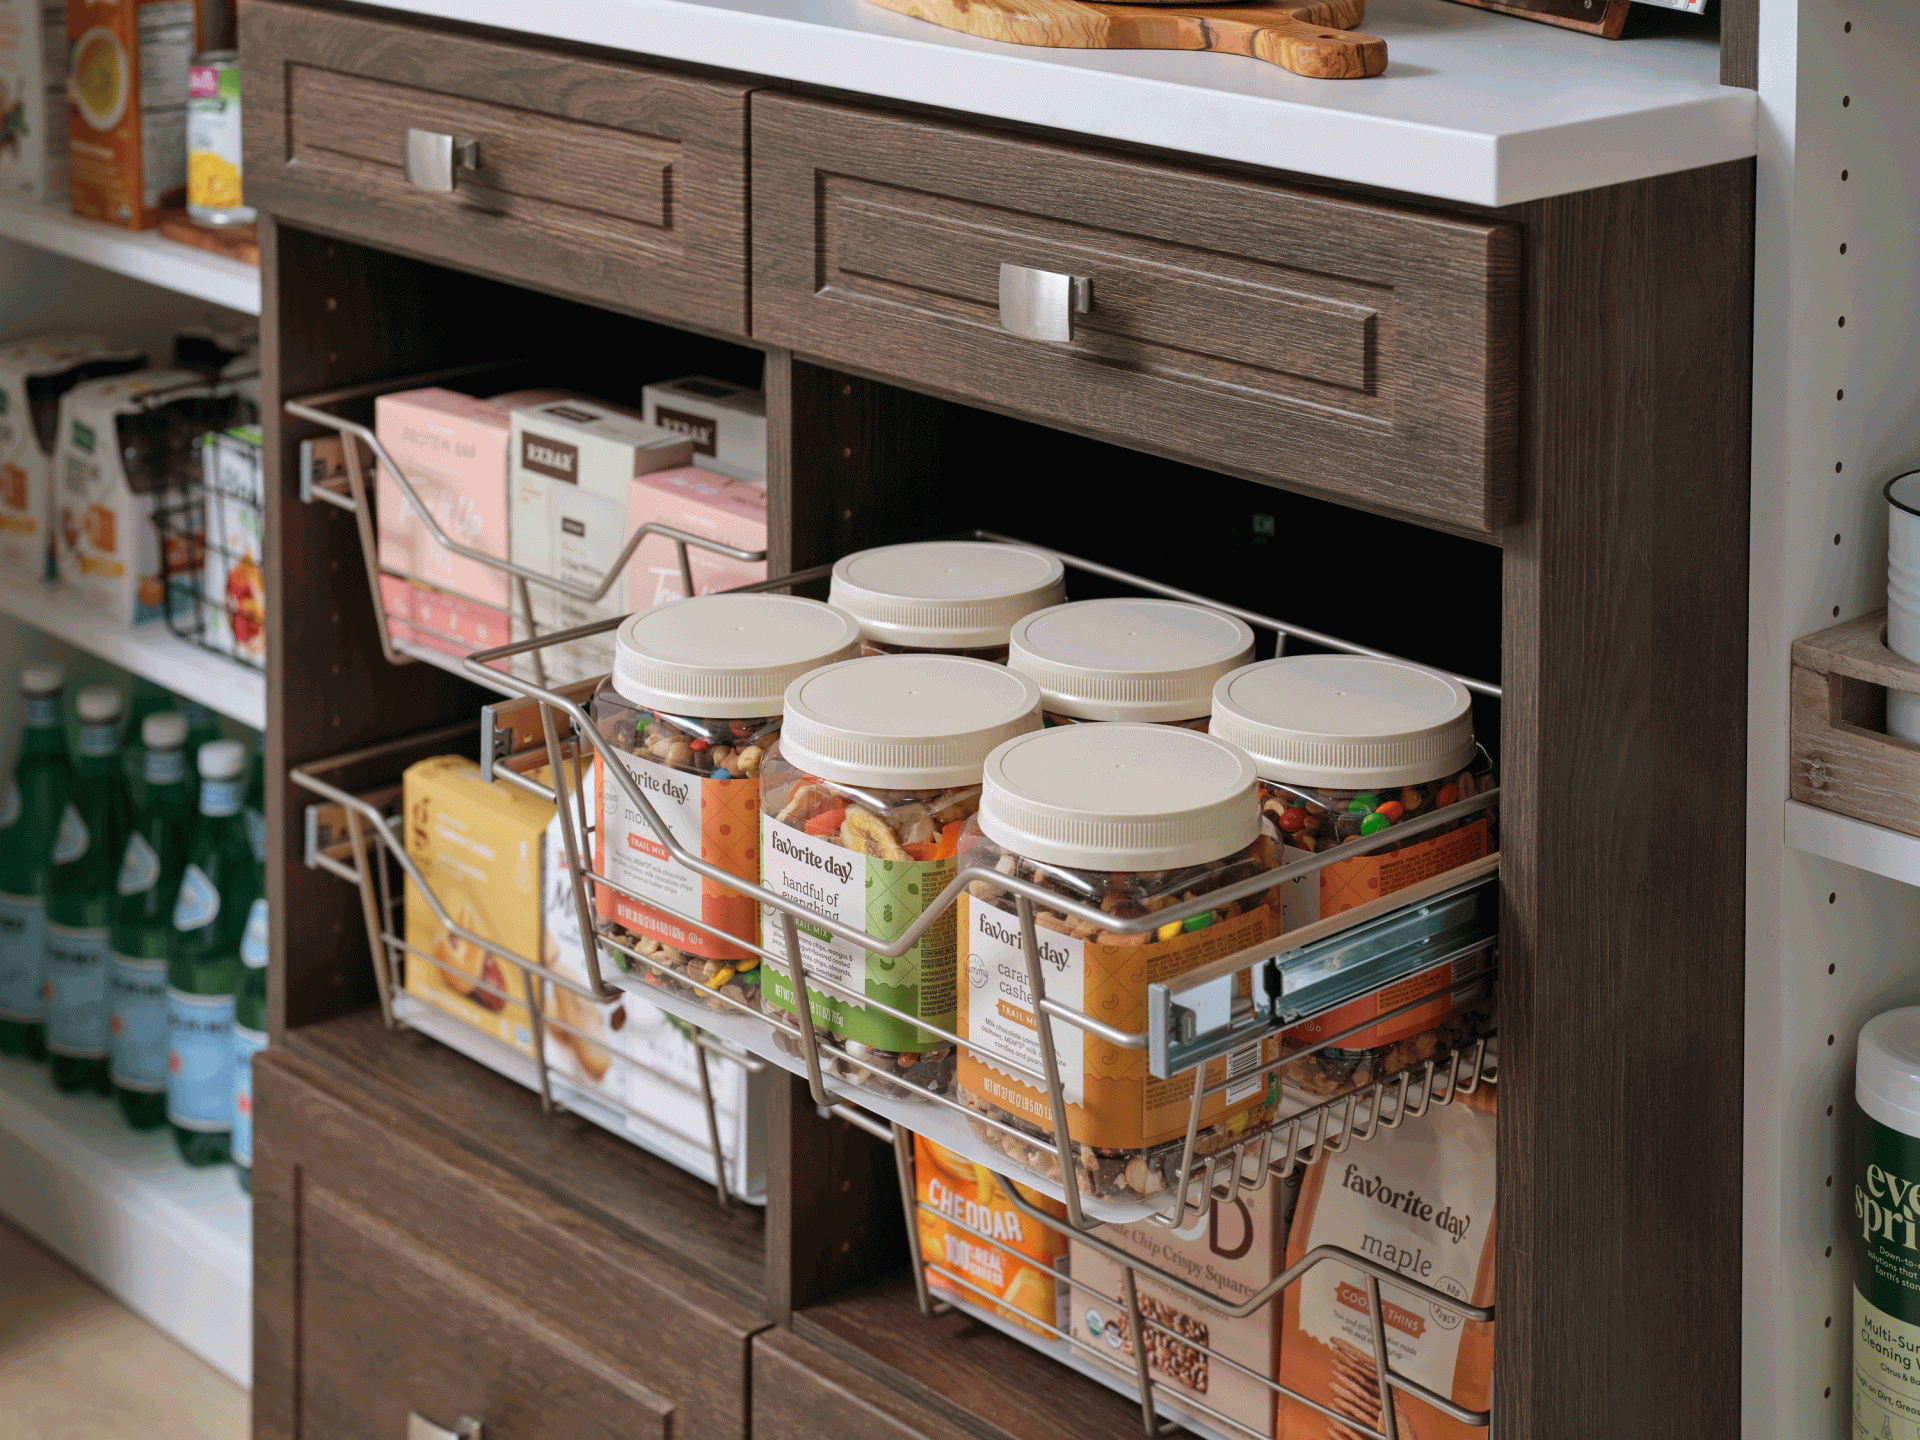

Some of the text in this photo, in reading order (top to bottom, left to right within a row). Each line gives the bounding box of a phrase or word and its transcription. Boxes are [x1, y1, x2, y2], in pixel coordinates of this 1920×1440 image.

[662, 779, 689, 806] day
[631, 837, 666, 858] TRAIL MIX
[772, 830, 852, 885] favorite day
[783, 871, 840, 908] handful of
[795, 917, 828, 938] RAIL MIX
[979, 913, 1023, 951] favori
[1038, 942, 1069, 971] day
[828, 964, 852, 978] almonds,
[832, 953, 851, 969] coated
[774, 983, 783, 998] NET
[783, 988, 791, 1002] WT
[999, 981, 1034, 1005] cashe
[1002, 1004, 1024, 1022] TRAIL
[985, 1018, 996, 1029] Milk
[995, 1025, 1022, 1041] chocolate
[994, 1041, 1015, 1056] candies
[1015, 1050, 1027, 1061] and
[984, 1077, 993, 1092] NET
[993, 1082, 1001, 1097] WT
[1001, 1086, 1008, 1101] 37
[1008, 1090, 1016, 1105] OZ
[1016, 1094, 1022, 1108] (2
[1022, 1097, 1029, 1111] LB
[1034, 1103, 1044, 1119] OZ)
[1867, 1163, 1920, 1217] eve
[928, 1178, 1023, 1242] CHEDDAR
[1342, 1163, 1471, 1244] favorite day
[1855, 1184, 1919, 1251] spri
[1131, 1228, 1161, 1257] Chip
[1162, 1245, 1202, 1279] Crispy
[1204, 1264, 1259, 1299] Squares
[1360, 1234, 1432, 1278] maple
[1867, 1250, 1918, 1281] solutions that
[1875, 1265, 1900, 1285] Earth's
[1445, 1283, 1461, 1298] ADD
[1388, 1308, 1420, 1332] THINS
[1864, 1315, 1920, 1354] Multi-Sur
[1861, 1328, 1912, 1371] Cleaning
[1880, 1362, 1902, 1380] Citrus
[1902, 1373, 1909, 1383] &
[1877, 1390, 1894, 1407] Dirt,
[1895, 1399, 1920, 1416] Greas
